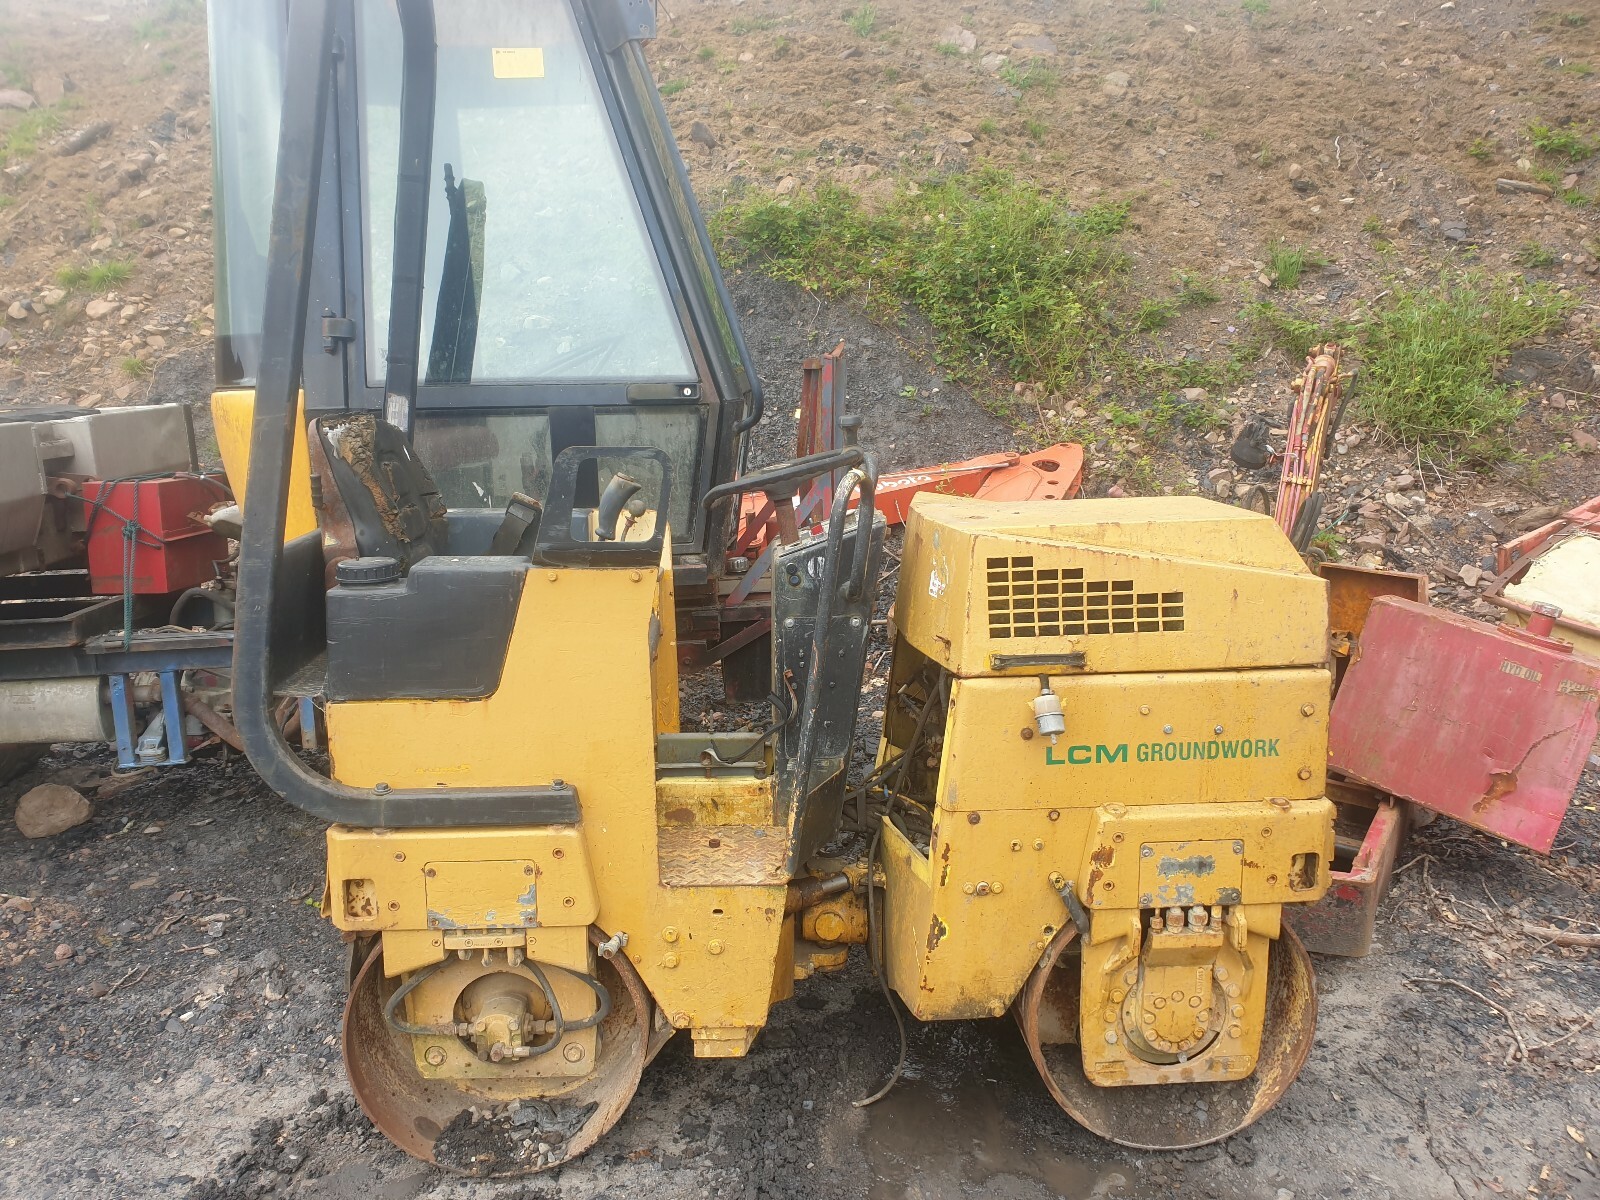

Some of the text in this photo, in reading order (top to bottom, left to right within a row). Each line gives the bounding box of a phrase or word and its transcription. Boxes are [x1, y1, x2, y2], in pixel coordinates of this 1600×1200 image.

[854, 474, 931, 493] ubota
[1045, 738, 1280, 765] LCM GROUNDWORK
